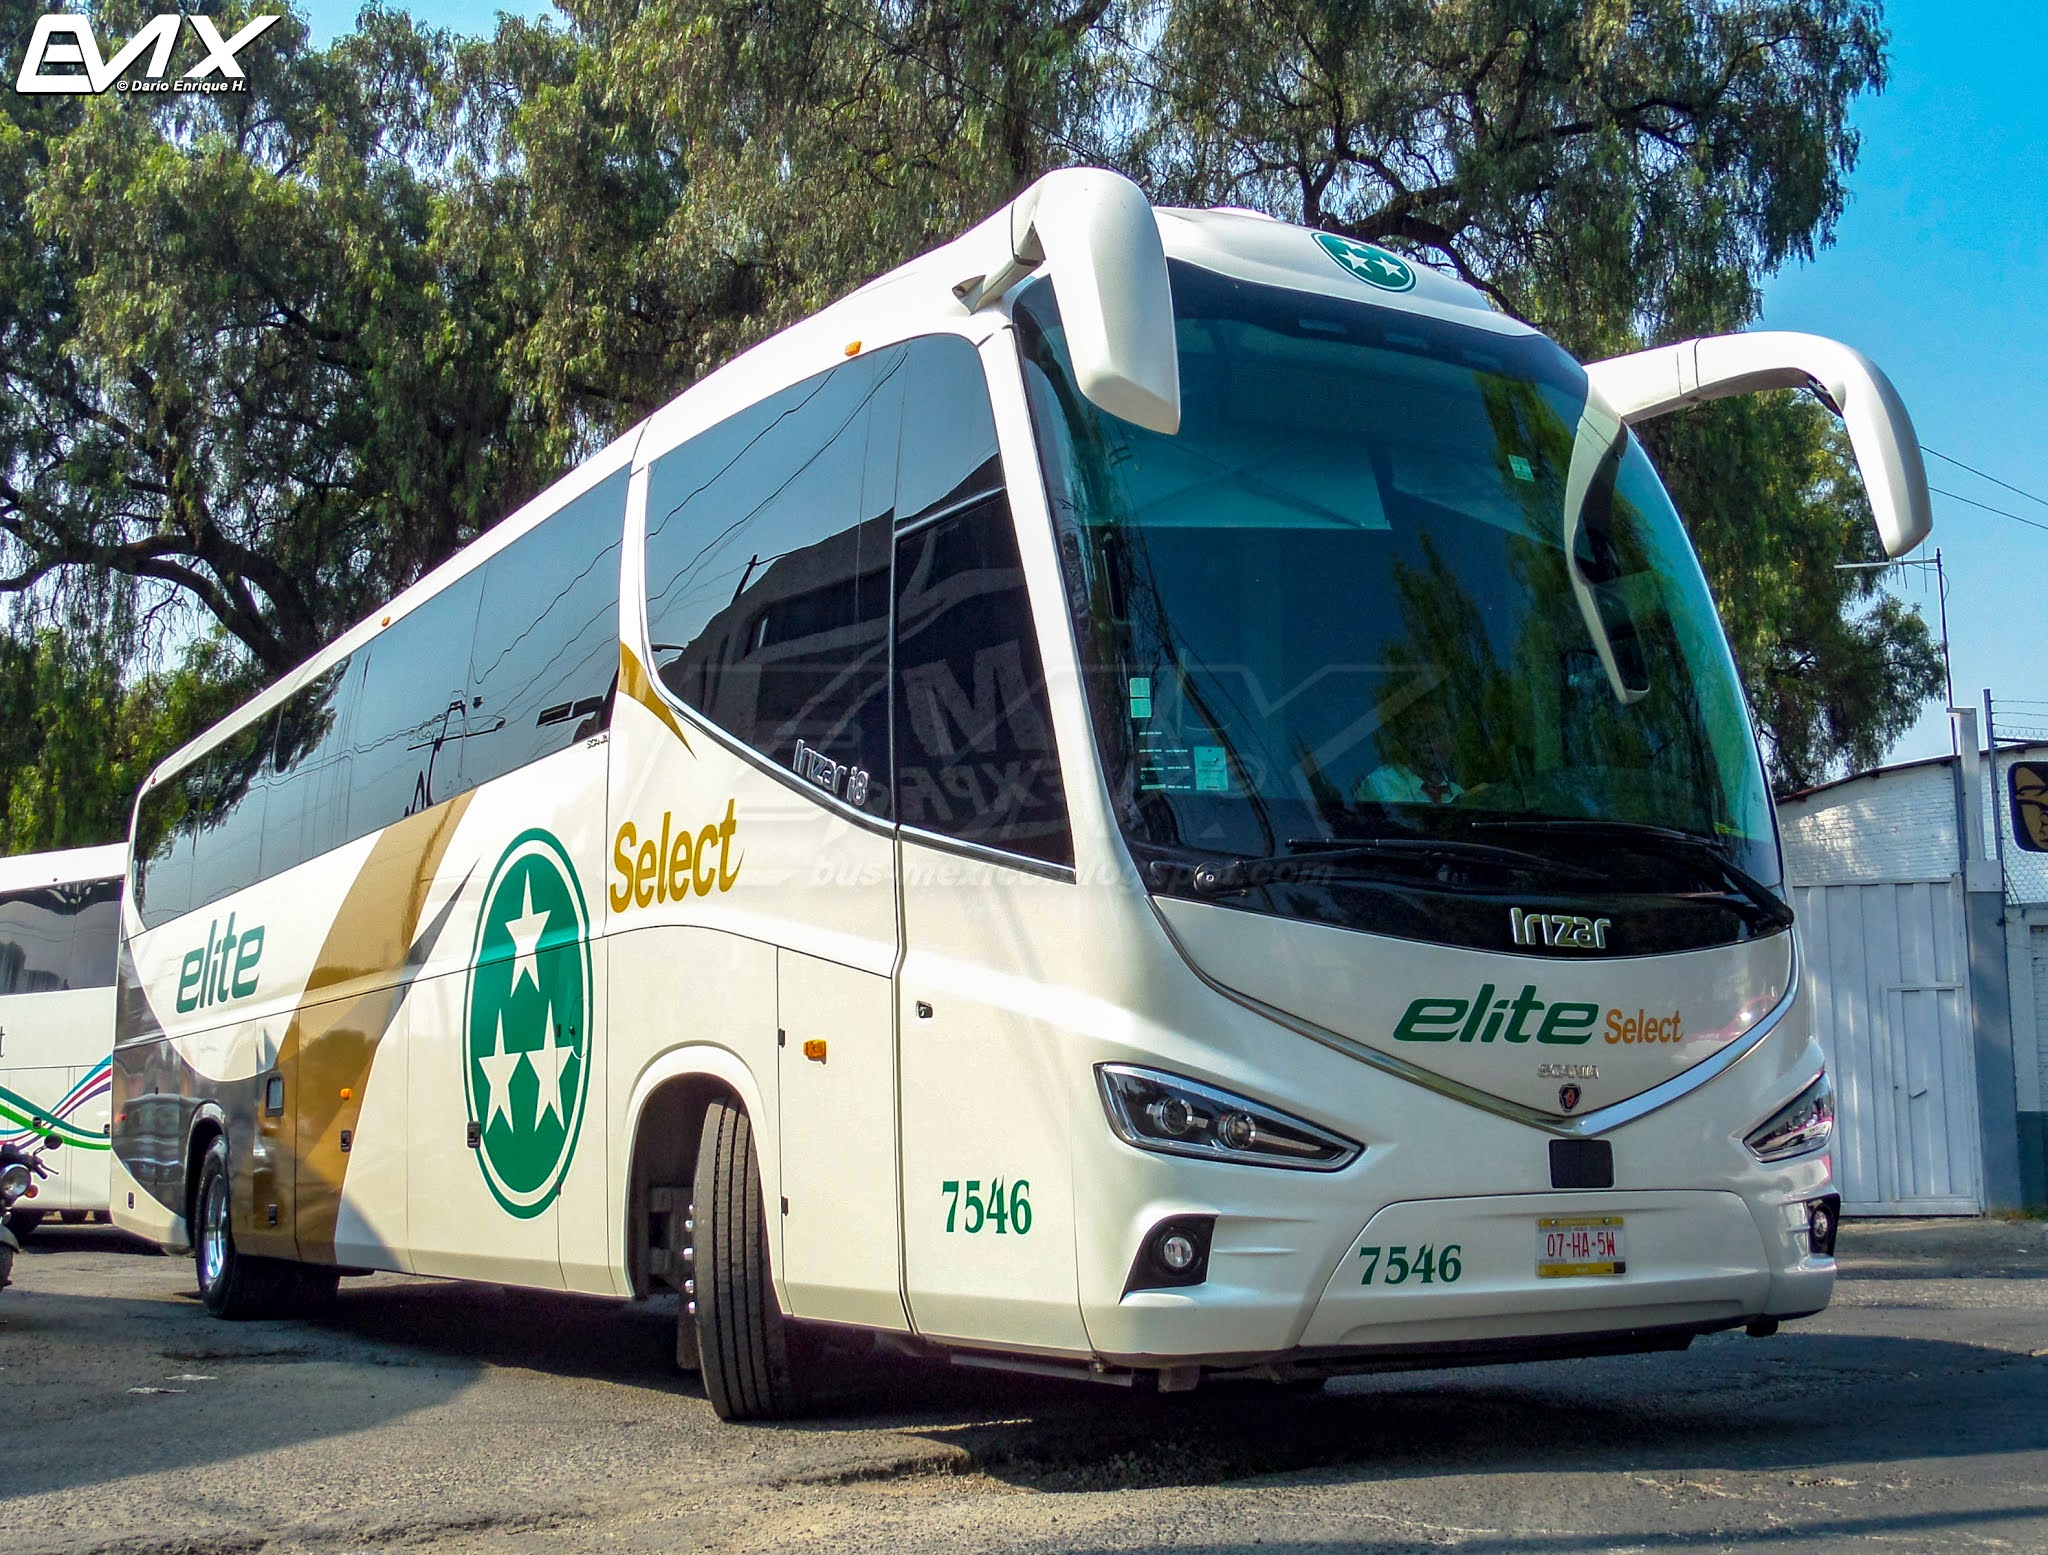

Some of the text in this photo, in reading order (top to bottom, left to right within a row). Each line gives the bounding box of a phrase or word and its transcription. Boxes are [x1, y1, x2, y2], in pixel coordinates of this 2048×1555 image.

[792, 738, 847, 795] Irizar
[610, 798, 745, 914] Select
[1510, 907, 1611, 950] Irizar
[176, 910, 266, 1014] elite
[1394, 983, 1685, 1045] elite Select
[1537, 1064, 1600, 1079] SCANIA
[941, 1174, 1032, 1235] 7546
[1359, 1243, 1462, 1285] 7546
[1546, 1231, 1616, 1258] 07-HA-5W
